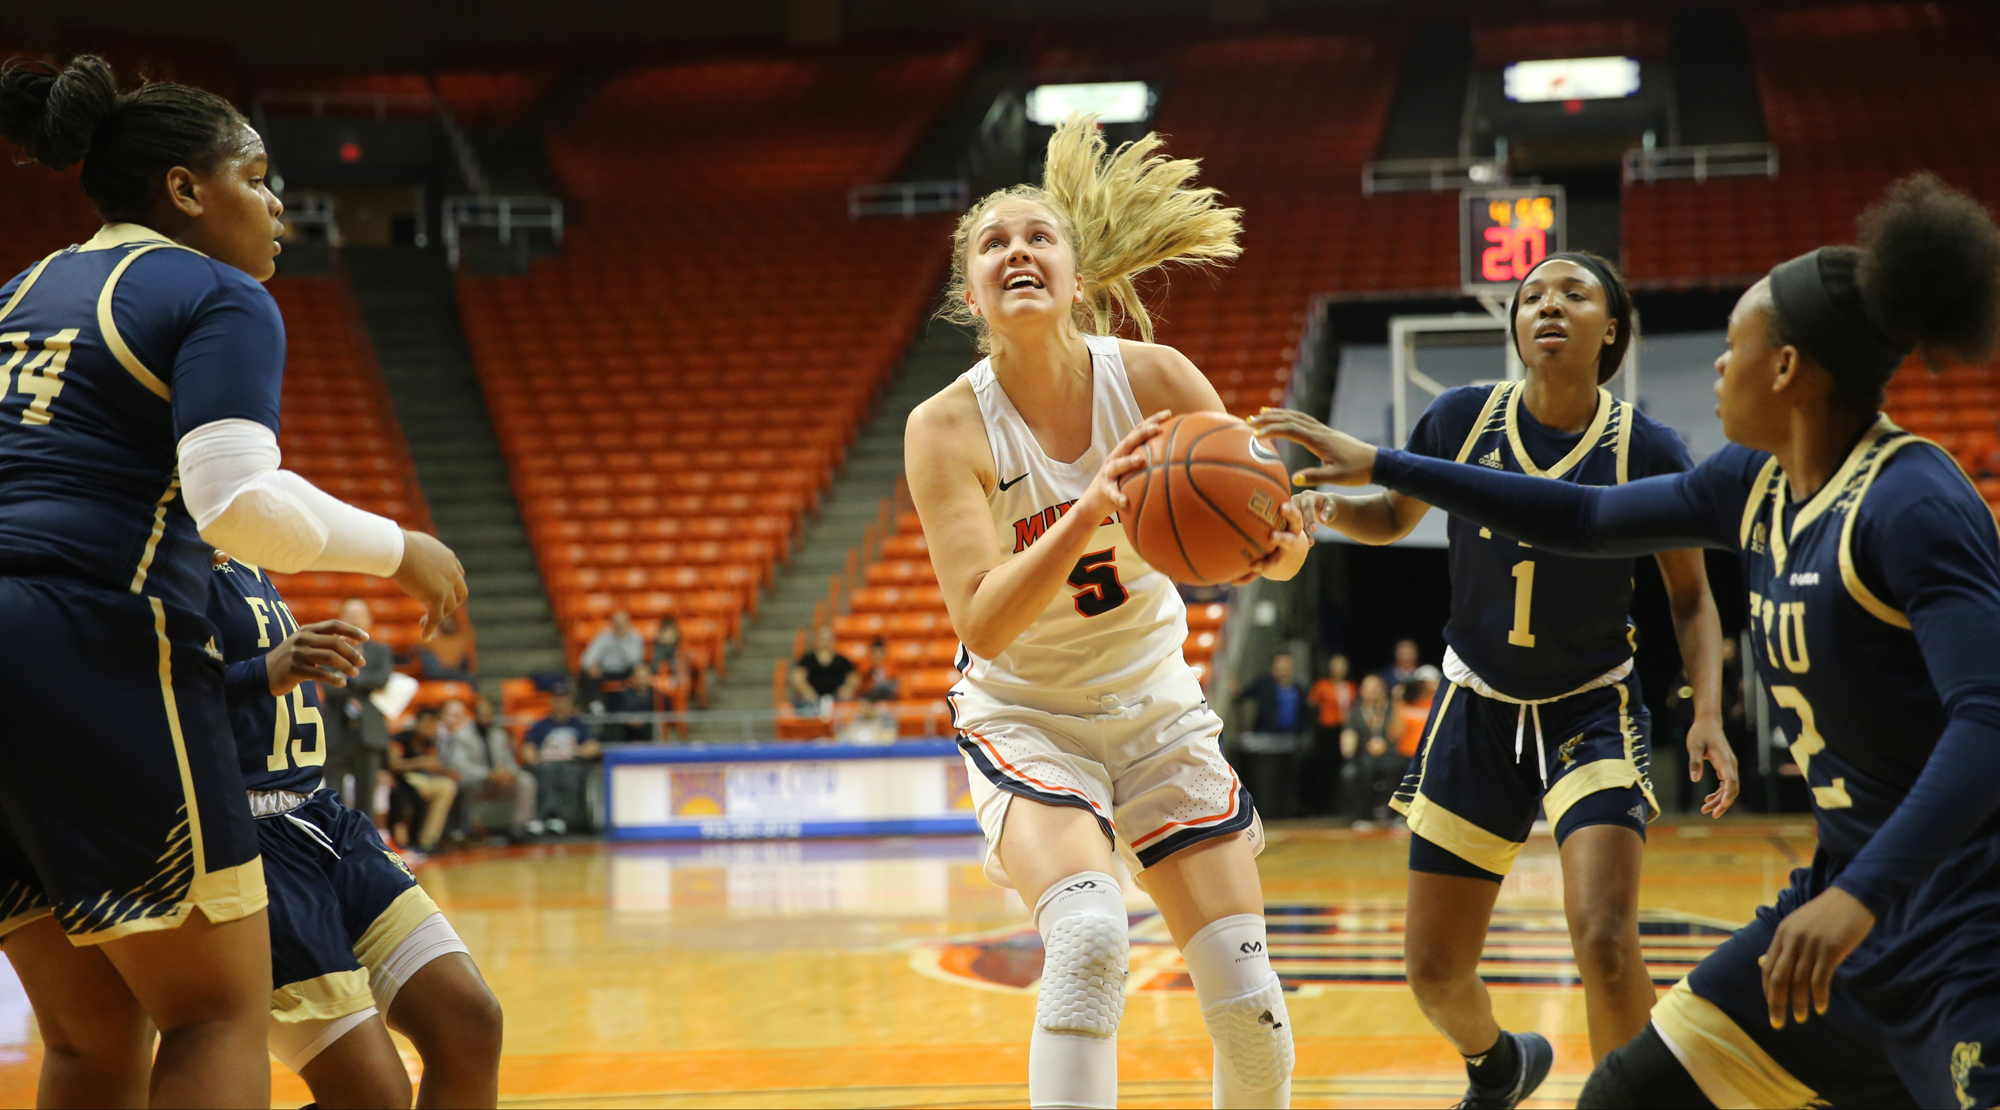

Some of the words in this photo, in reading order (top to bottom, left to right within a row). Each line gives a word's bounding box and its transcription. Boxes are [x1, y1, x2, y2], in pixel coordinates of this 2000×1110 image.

[1482, 226, 1546, 281] 20
[1066, 545, 1130, 618] 5
[1508, 560, 1535, 648] 1
[267, 680, 327, 772] 15
